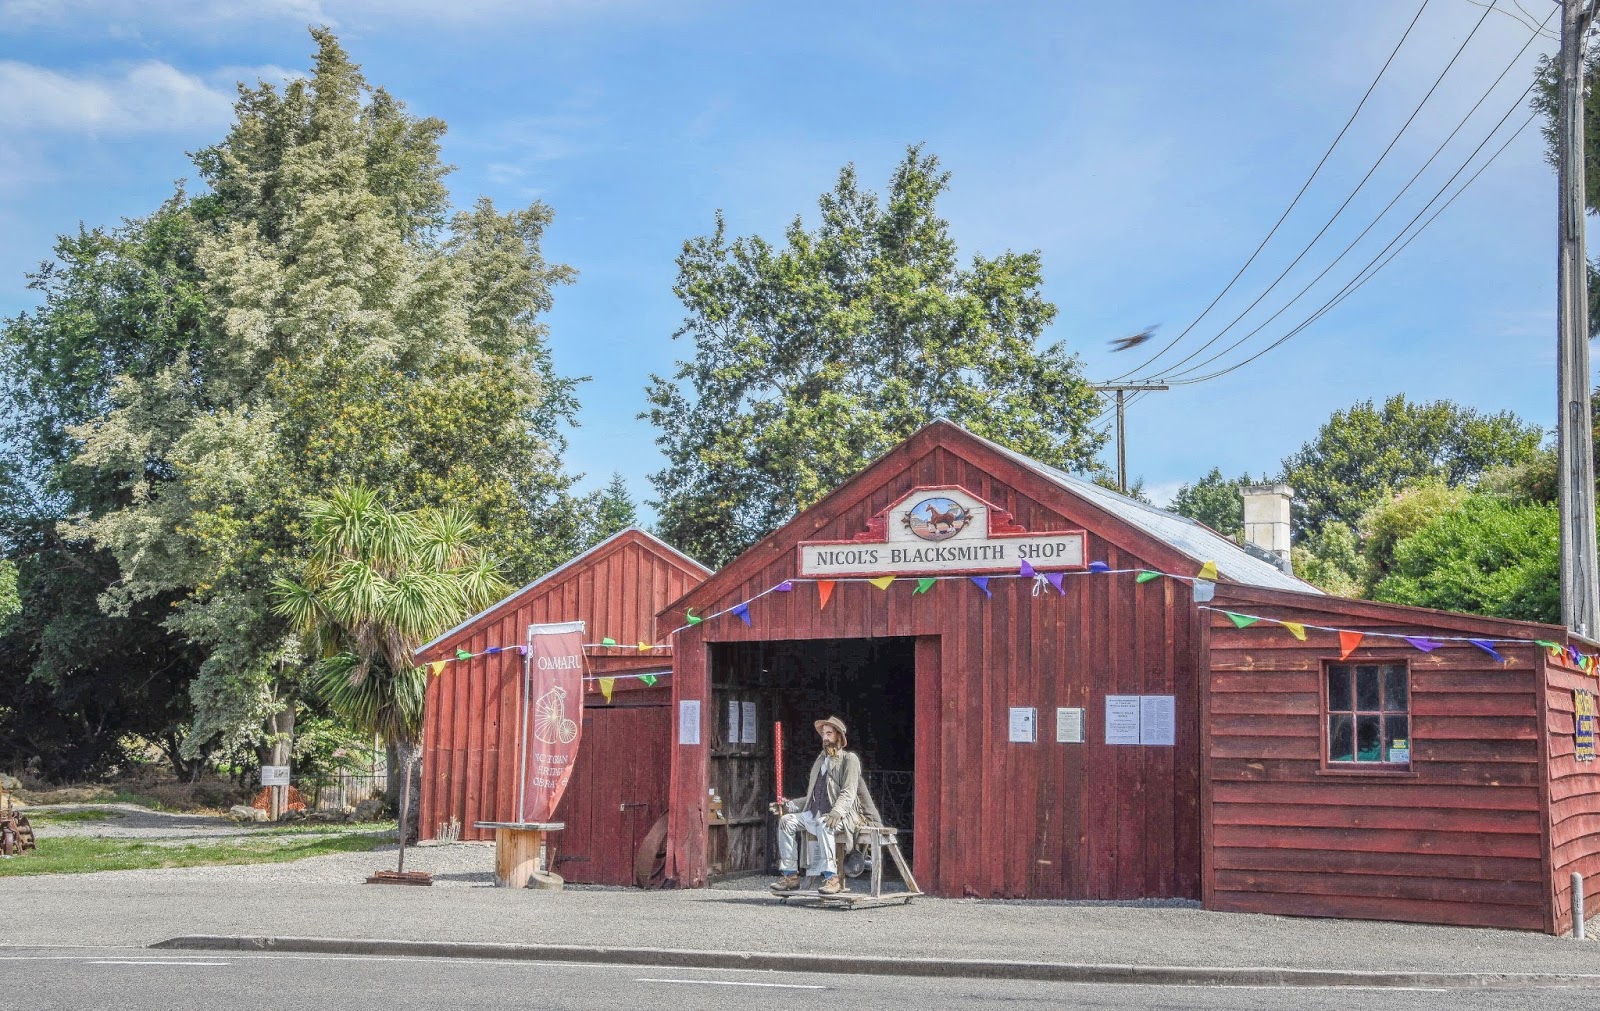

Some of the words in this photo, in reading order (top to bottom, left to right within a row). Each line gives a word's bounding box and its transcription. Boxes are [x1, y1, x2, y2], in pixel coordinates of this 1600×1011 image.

[816, 549, 878, 566] NICOL'S
[890, 544, 1005, 564] BLACKSMITH
[1018, 542, 1067, 559] SHOP
